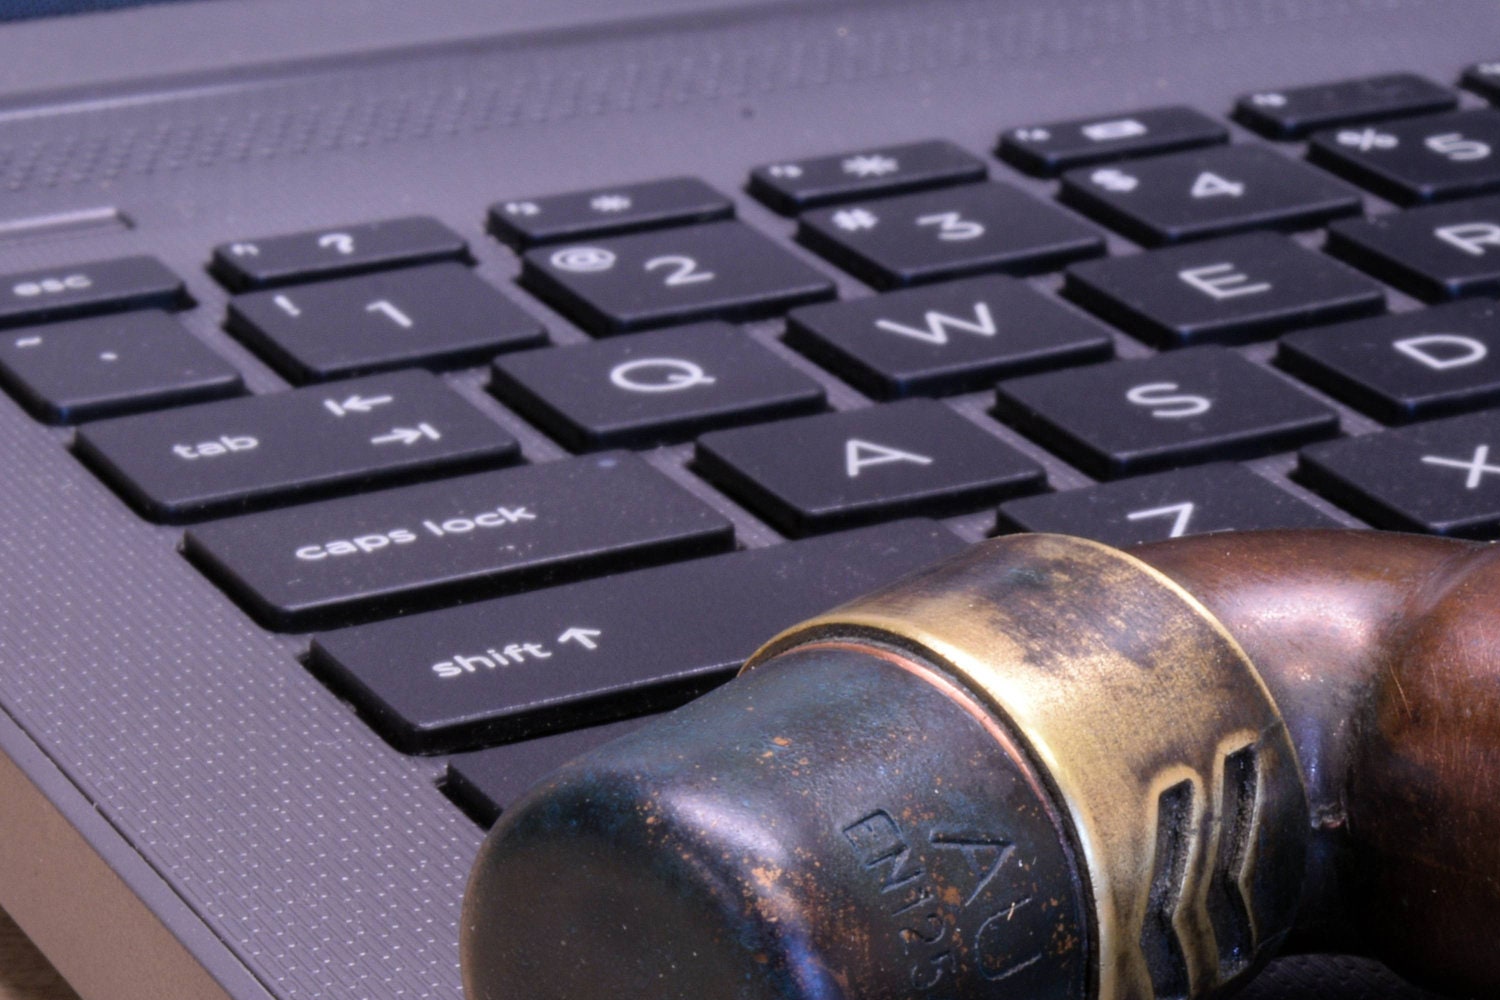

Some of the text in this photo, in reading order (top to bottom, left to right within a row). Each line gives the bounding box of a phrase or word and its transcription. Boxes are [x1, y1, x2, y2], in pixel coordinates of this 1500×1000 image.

[1425, 133, 1491, 161] 5
[1191, 171, 1243, 198] 4
[917, 211, 985, 241] 3
[550, 247, 616, 272] @
[644, 255, 714, 286] 2
[1178, 263, 1271, 299] E
[366, 300, 413, 328] 1
[875, 302, 997, 345] W
[1393, 334, 1487, 370] D
[609, 357, 716, 393] Q
[1126, 382, 1211, 418] S
[172, 435, 259, 460] tab
[845, 438, 933, 478] A
[295, 506, 537, 561] caps lock
[431, 642, 553, 678] shift
